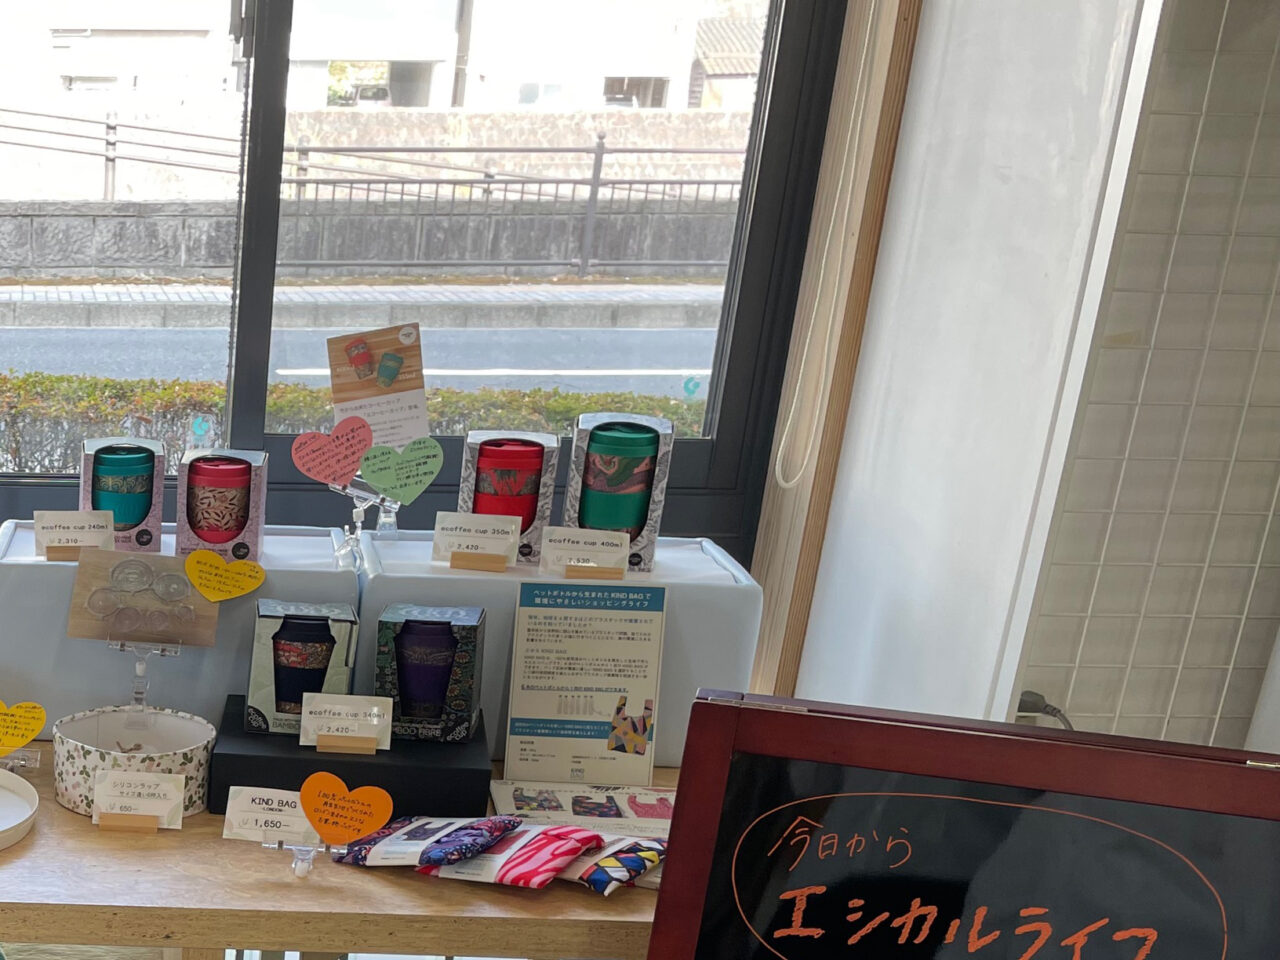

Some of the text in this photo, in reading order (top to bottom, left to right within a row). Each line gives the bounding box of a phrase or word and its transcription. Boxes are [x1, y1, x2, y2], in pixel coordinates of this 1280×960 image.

[440, 525, 472, 533] ecoffee
[474, 528, 488, 536] cup
[308, 709, 342, 717] ecoffee
[345, 711, 359, 719] cup
[112, 781, 161, 790] シリコンラップ
[251, 796, 297, 809] KIND BAG
[767, 815, 913, 872] 今日から
